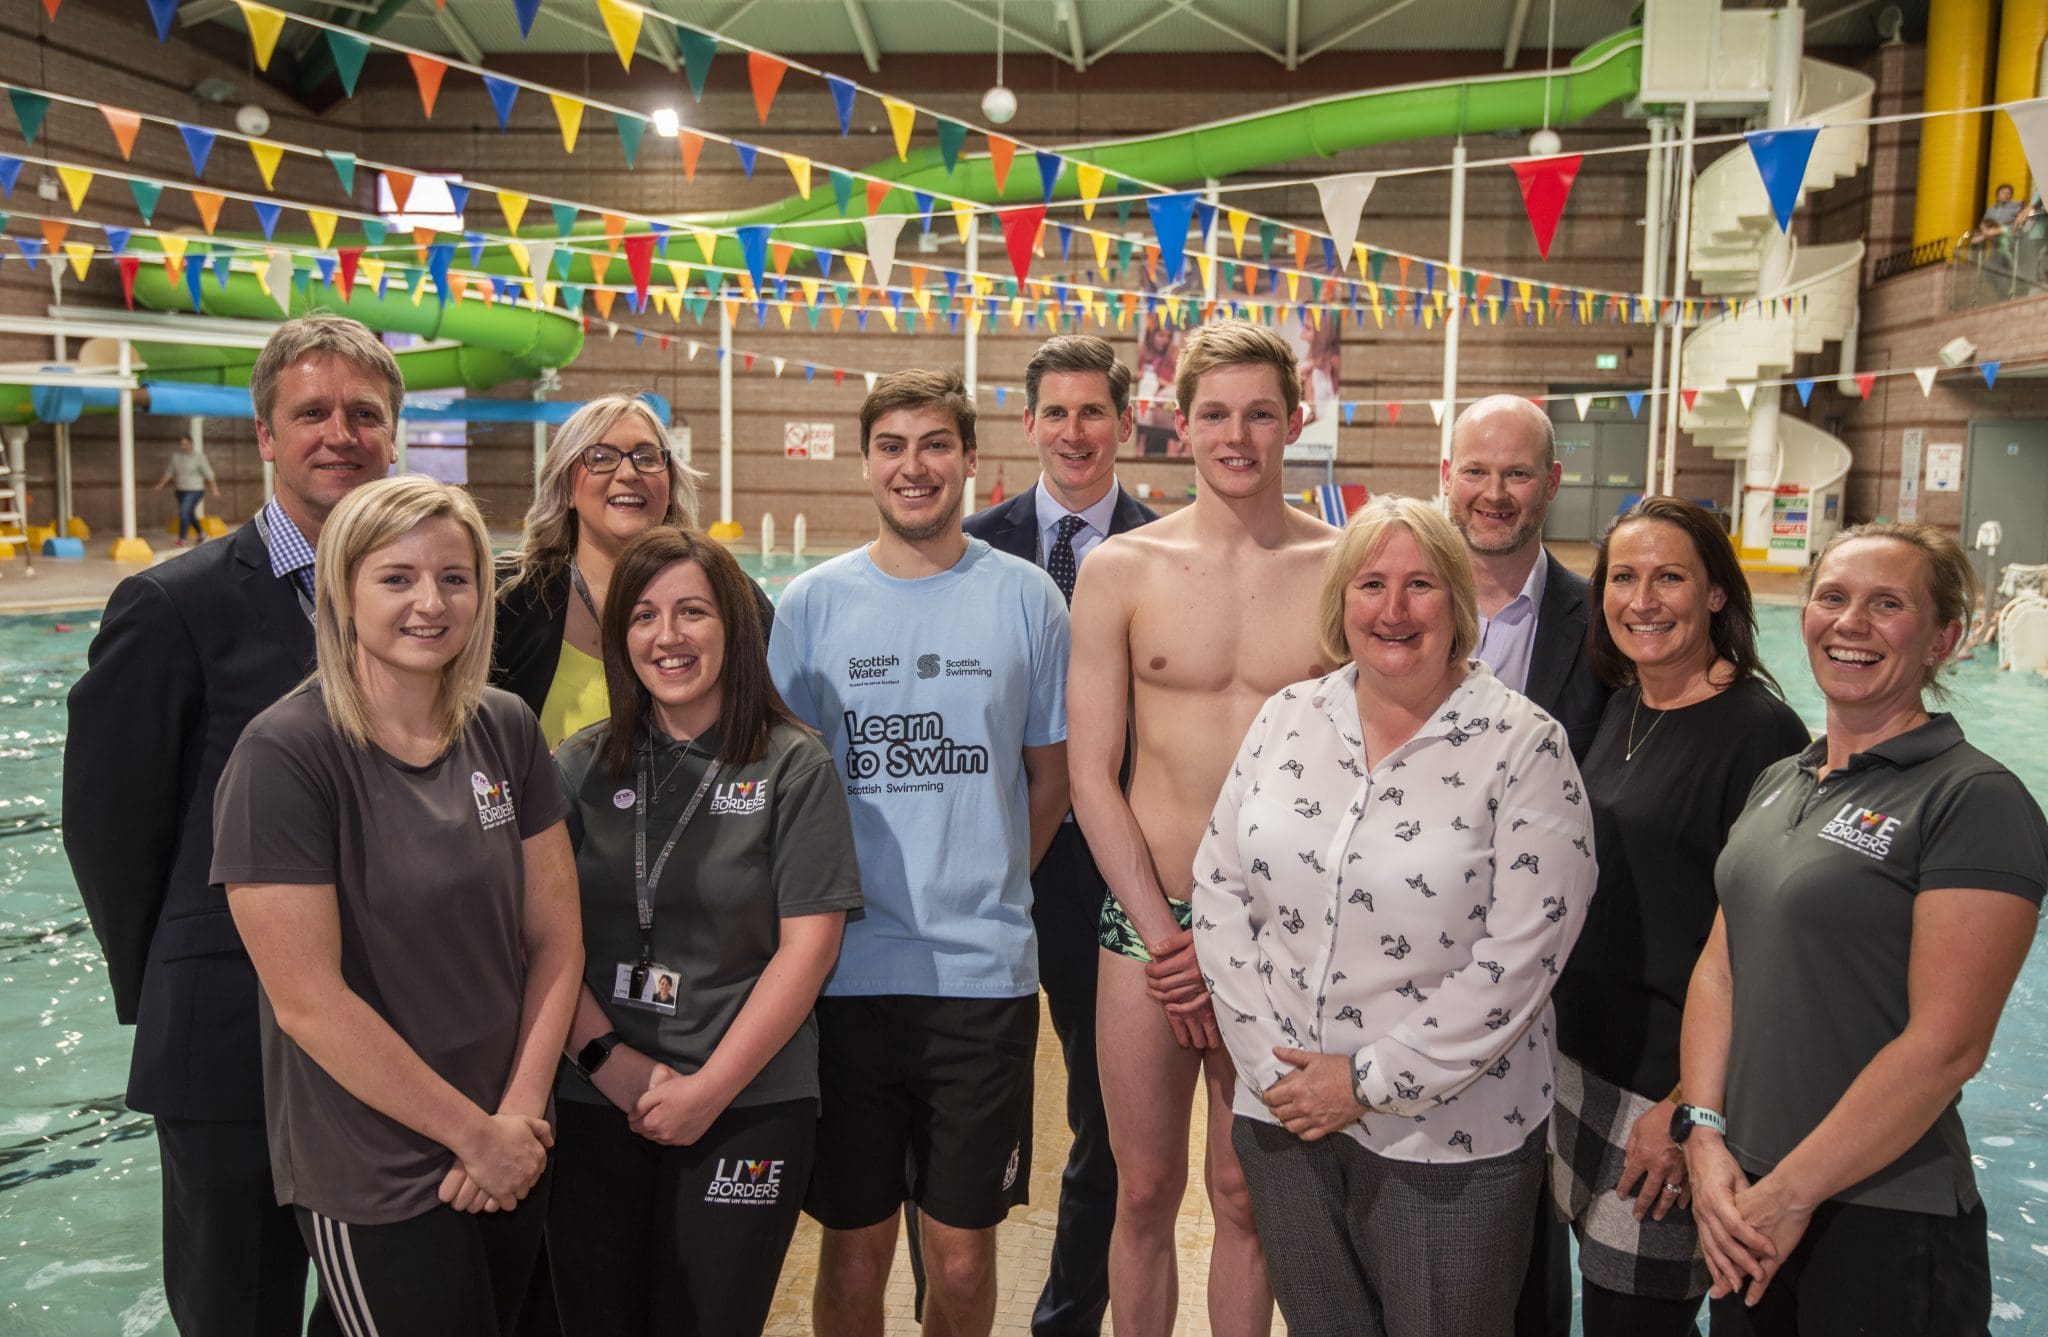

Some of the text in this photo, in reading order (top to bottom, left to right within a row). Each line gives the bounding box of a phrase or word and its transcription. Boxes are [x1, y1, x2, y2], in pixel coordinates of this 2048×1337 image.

[849, 655, 900, 669] Scottish
[946, 659, 980, 668] Scottish
[848, 667, 888, 680] Water
[945, 668, 992, 677] Swimming
[844, 710, 944, 745] Learn
[846, 738, 989, 779] to Swim
[714, 779, 768, 800] LIVE
[847, 781, 944, 796] Scottish Swimming
[710, 797, 766, 810] BORDERS
[1834, 803, 1902, 841] LIVE
[1822, 821, 1892, 855] BORDERS
[715, 1158, 784, 1183] LIVE
[707, 1181, 780, 1198] BORDERS
